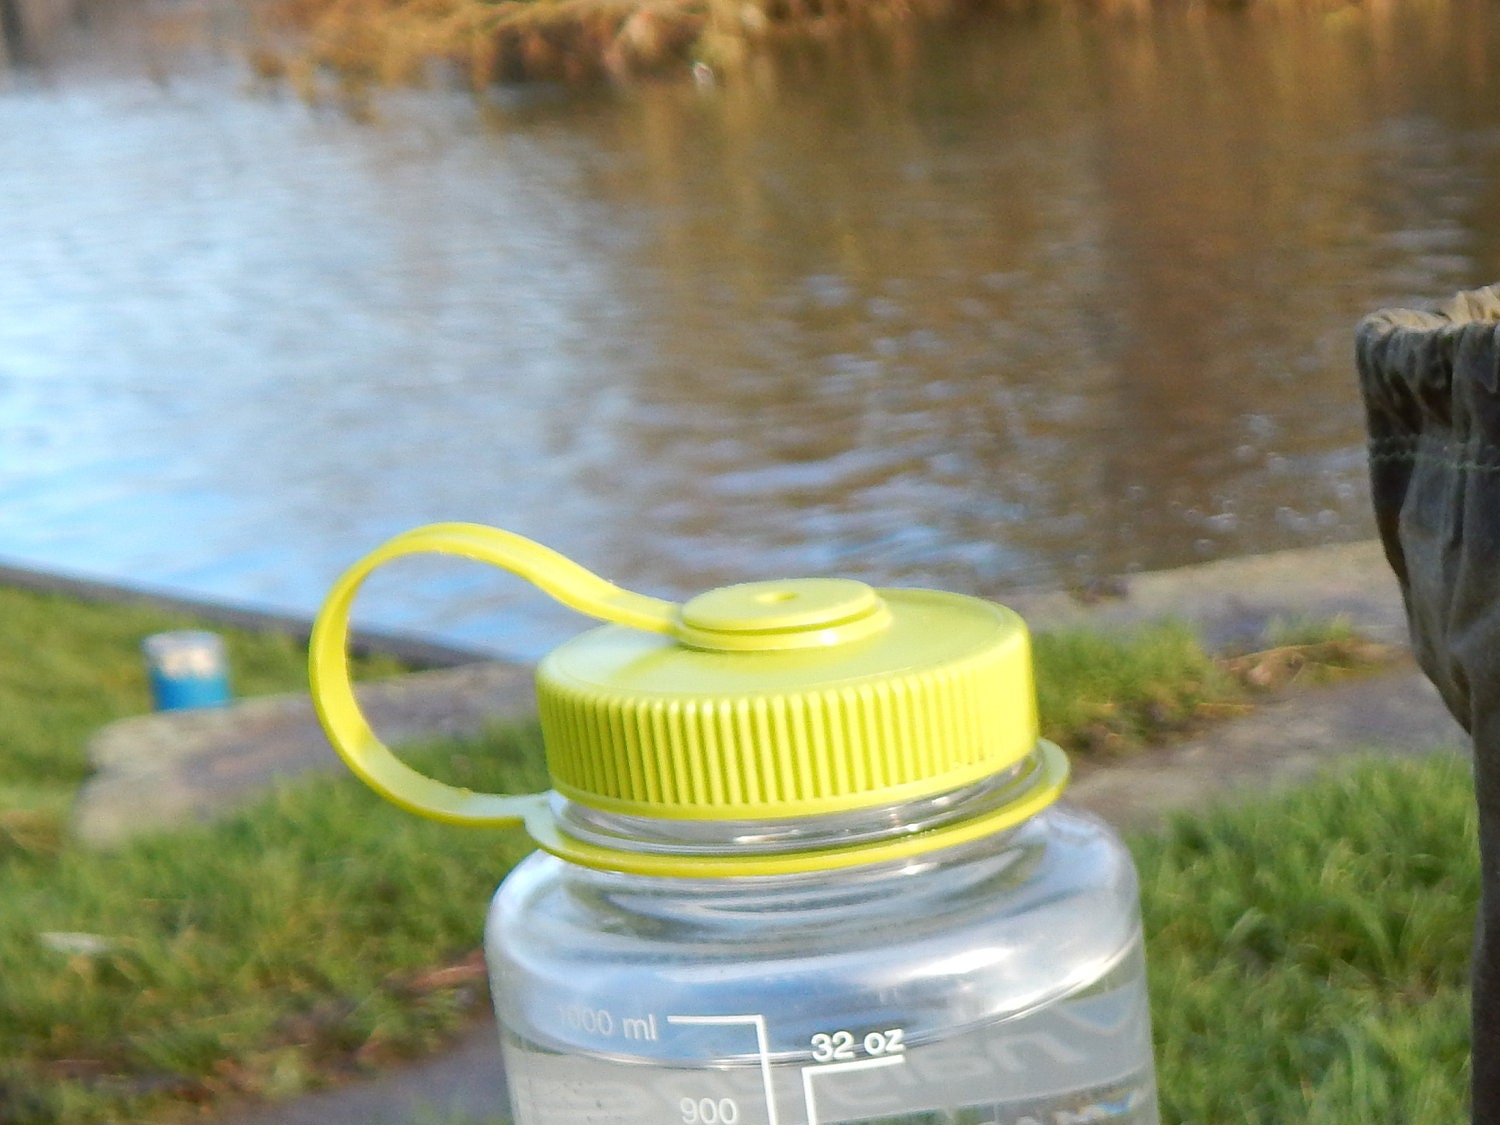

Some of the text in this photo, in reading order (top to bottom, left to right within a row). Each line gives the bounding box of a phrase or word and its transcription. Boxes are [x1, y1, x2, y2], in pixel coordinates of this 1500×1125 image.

[624, 1013, 658, 1042] ml
[811, 1027, 905, 1063] 32 oz
